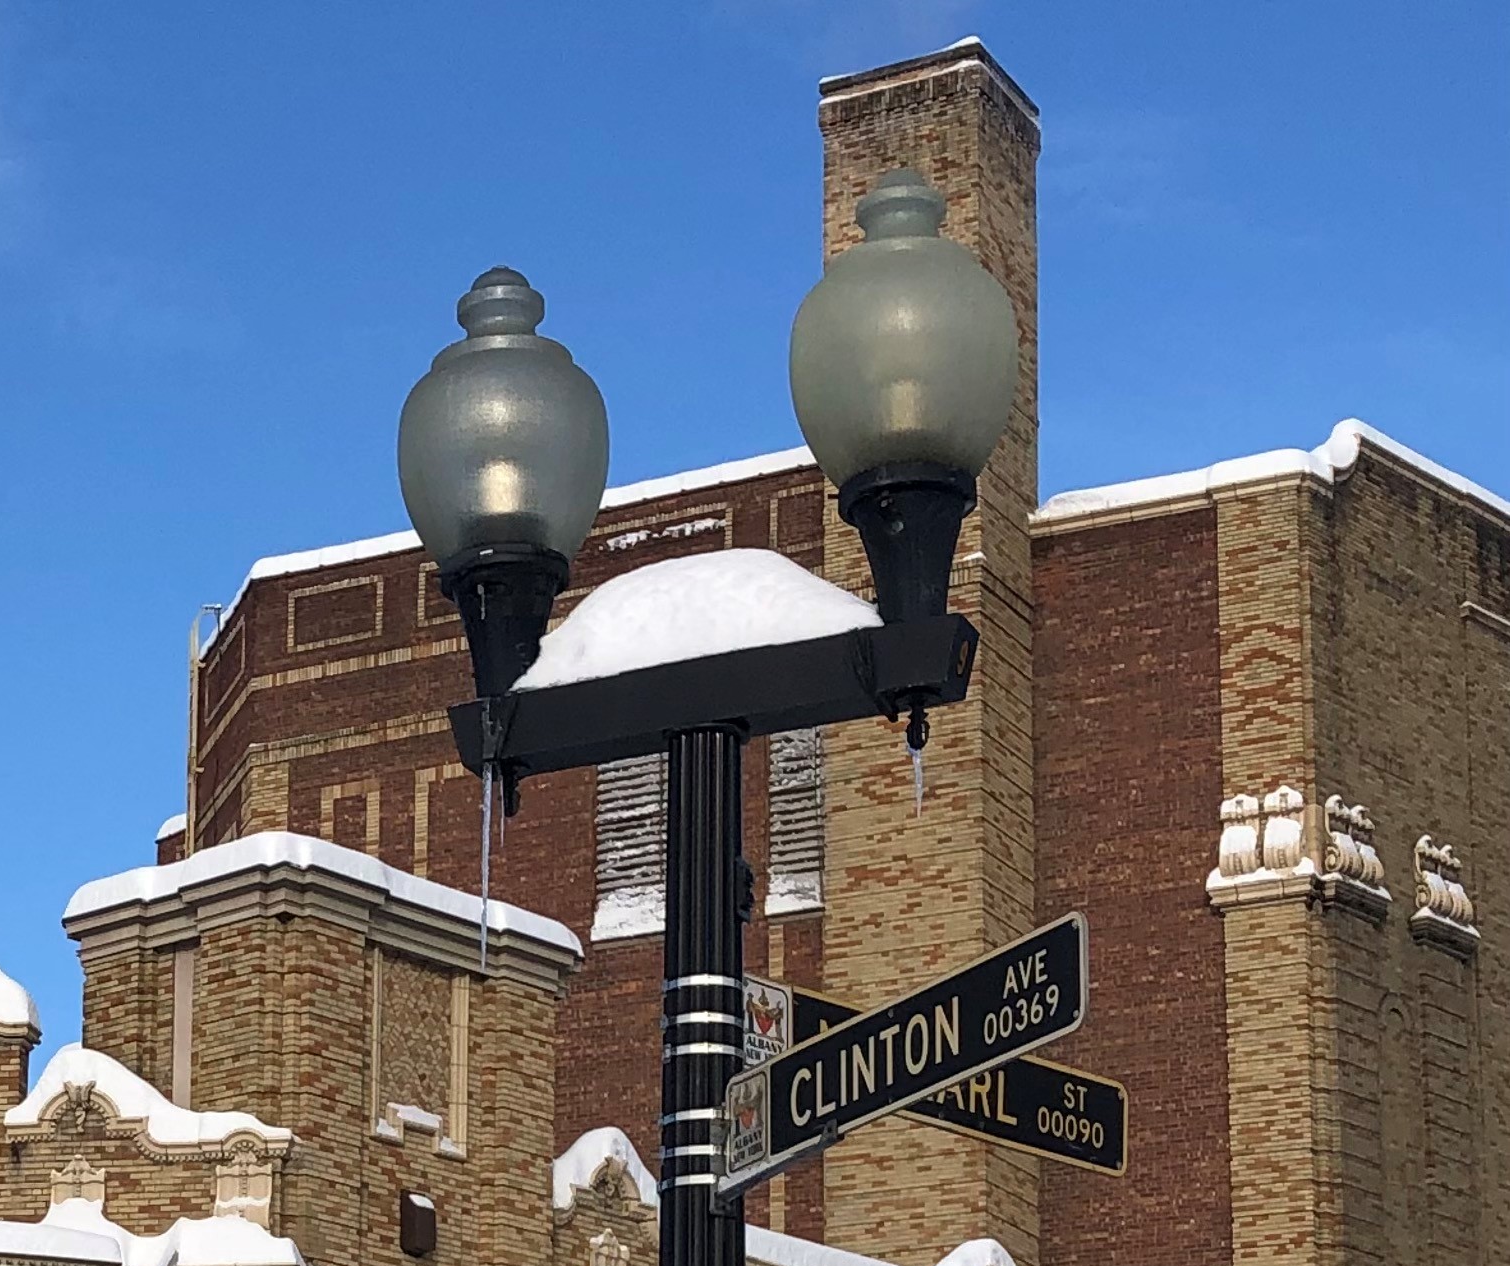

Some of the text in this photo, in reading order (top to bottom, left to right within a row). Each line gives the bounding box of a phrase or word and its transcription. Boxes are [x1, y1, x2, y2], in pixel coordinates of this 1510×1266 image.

[1002, 948, 1048, 999] AVE
[983, 984, 1060, 1046] 00369
[790, 996, 960, 1128] CLINTON
[1064, 1082, 1088, 1112] ST
[1038, 1105, 1104, 1149] 00090
